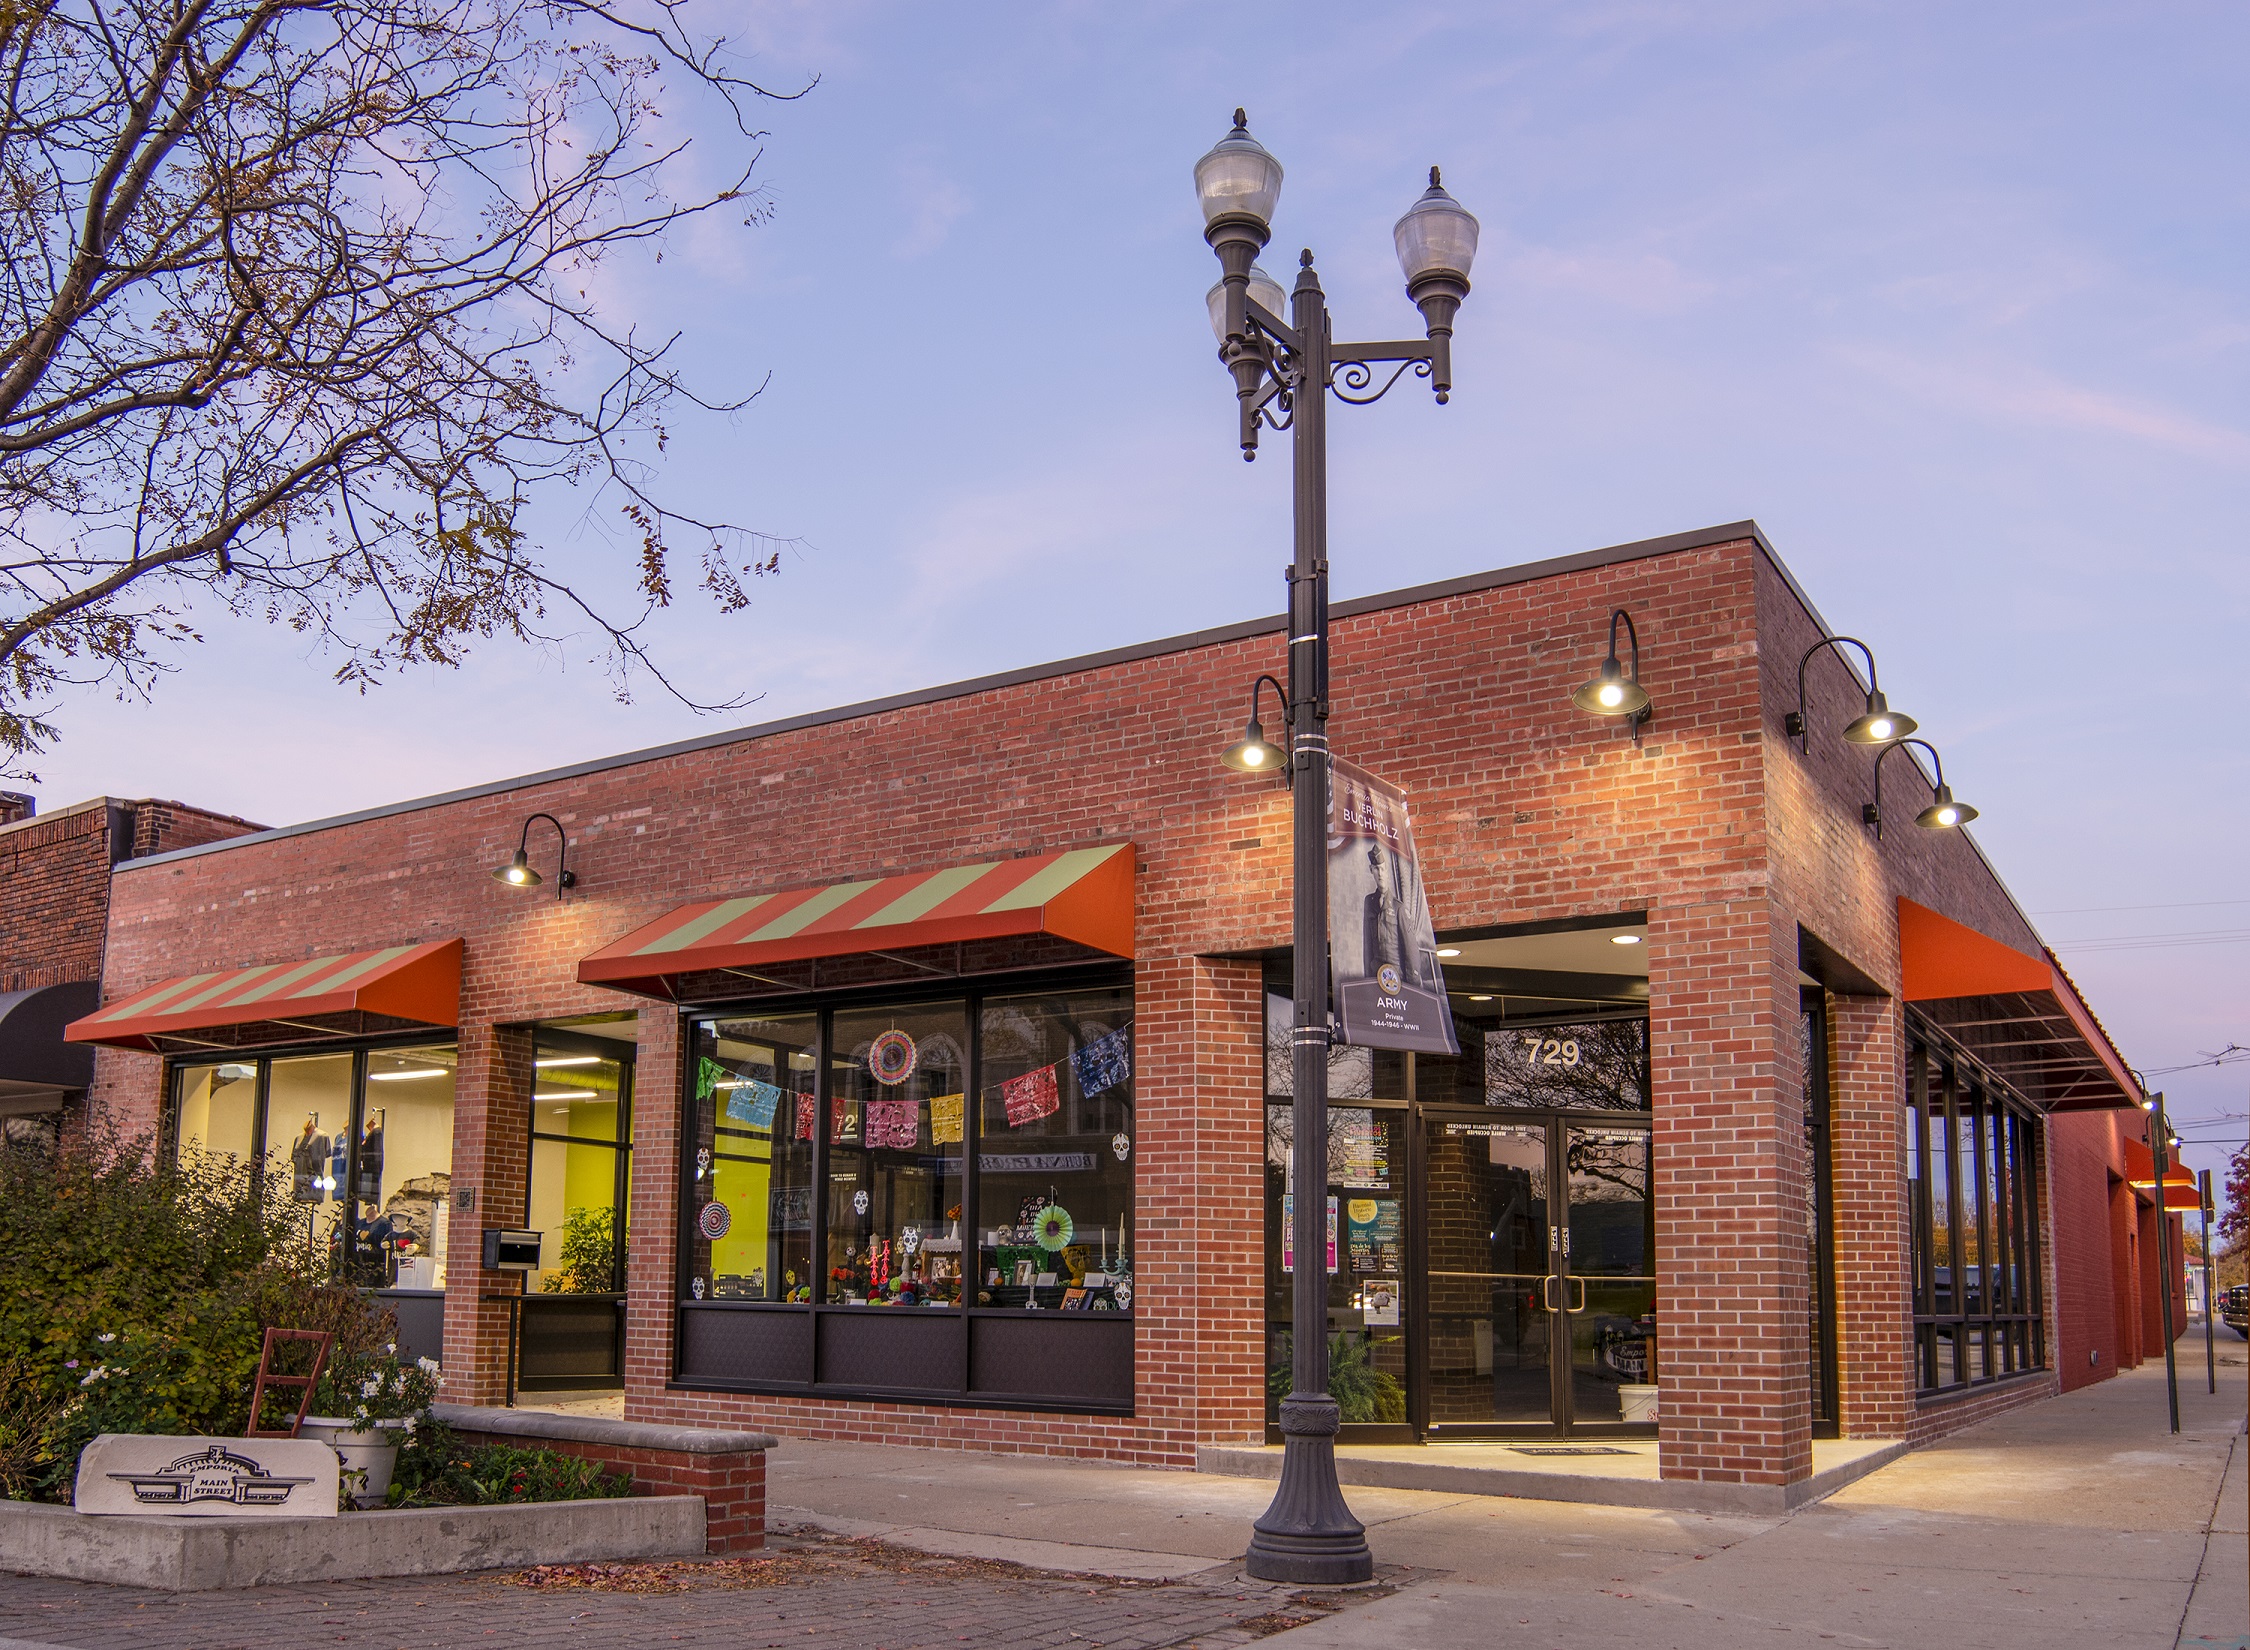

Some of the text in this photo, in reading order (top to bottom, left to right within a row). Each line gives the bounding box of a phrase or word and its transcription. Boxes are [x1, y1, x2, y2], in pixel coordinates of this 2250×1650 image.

[1356, 801, 1384, 820] VERLIN
[1343, 808, 1400, 840] BUCHHOLZ
[1377, 997, 1408, 1011] ARMY
[1385, 1013, 1404, 1021] Private
[1525, 1038, 1580, 1066] 729
[189, 1464, 240, 1474] EMPORIA
